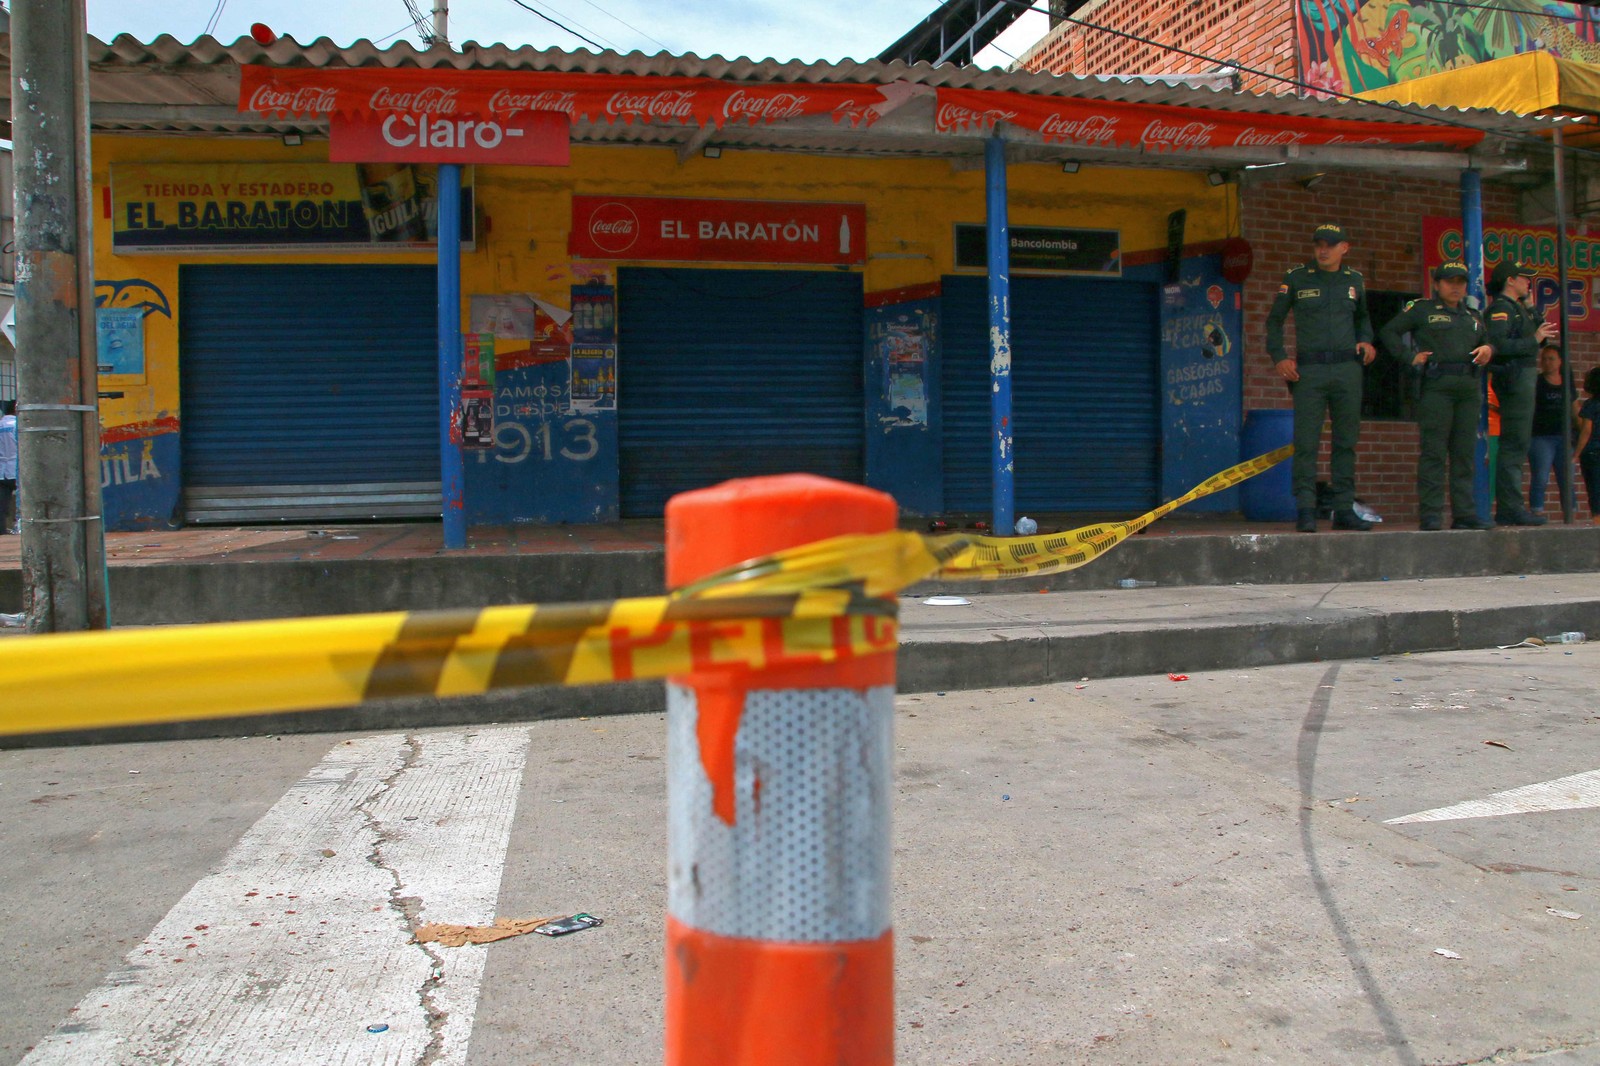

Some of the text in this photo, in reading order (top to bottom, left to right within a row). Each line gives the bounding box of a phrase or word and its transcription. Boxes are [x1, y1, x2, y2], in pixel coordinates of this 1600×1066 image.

[249, 84, 338, 112] Coca-Cola
[369, 87, 459, 114] Coca-Cola
[606, 90, 696, 116] Coca-Cola
[1039, 113, 1120, 141] Coca-Cola
[1140, 119, 1217, 146] Coca-Cola
[144, 183, 334, 197] TIENDA Y ESTADERO
[126, 201, 164, 229] EL
[592, 218, 634, 235] Coca-Cola
[660, 219, 819, 242] EL BARATÓN
[1010, 238, 1078, 250] Bancolombia
[477, 419, 599, 464] 913
